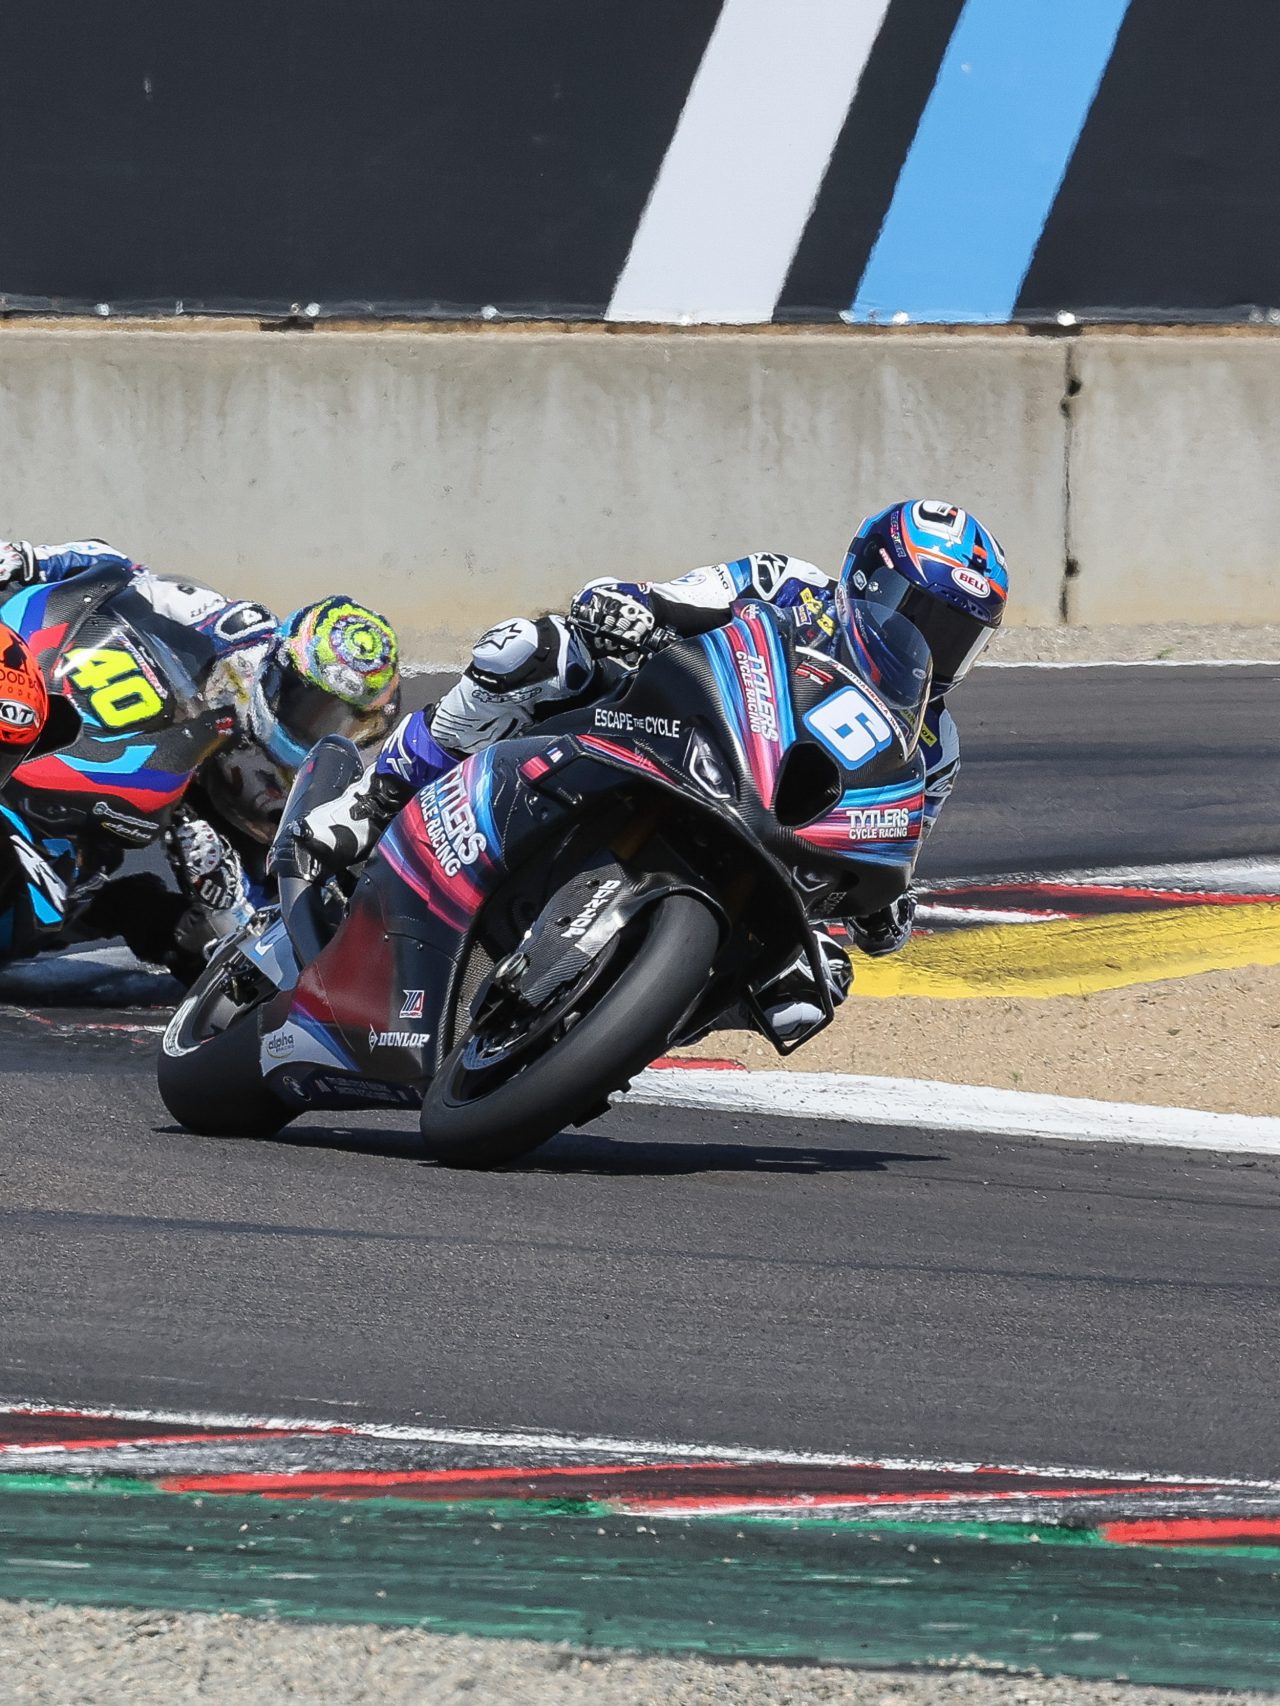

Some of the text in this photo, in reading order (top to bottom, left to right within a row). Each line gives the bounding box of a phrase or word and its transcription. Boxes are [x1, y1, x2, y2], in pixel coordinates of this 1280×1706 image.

[712, 565, 729, 591] pha
[959, 572, 986, 593] BELL
[63, 648, 163, 727] 40
[735, 650, 761, 733] CYCLE RACING
[747, 655, 779, 742] TYTLERS
[595, 708, 681, 738] ESCAPE THE CYCLE
[808, 689, 891, 762] 6
[846, 808, 909, 828] TYTLERS
[849, 827, 907, 840] CYCLE RACING
[425, 816, 462, 877] RACING
[560, 880, 621, 938] DUNLOP
[378, 1031, 431, 1048] DUNLOP
